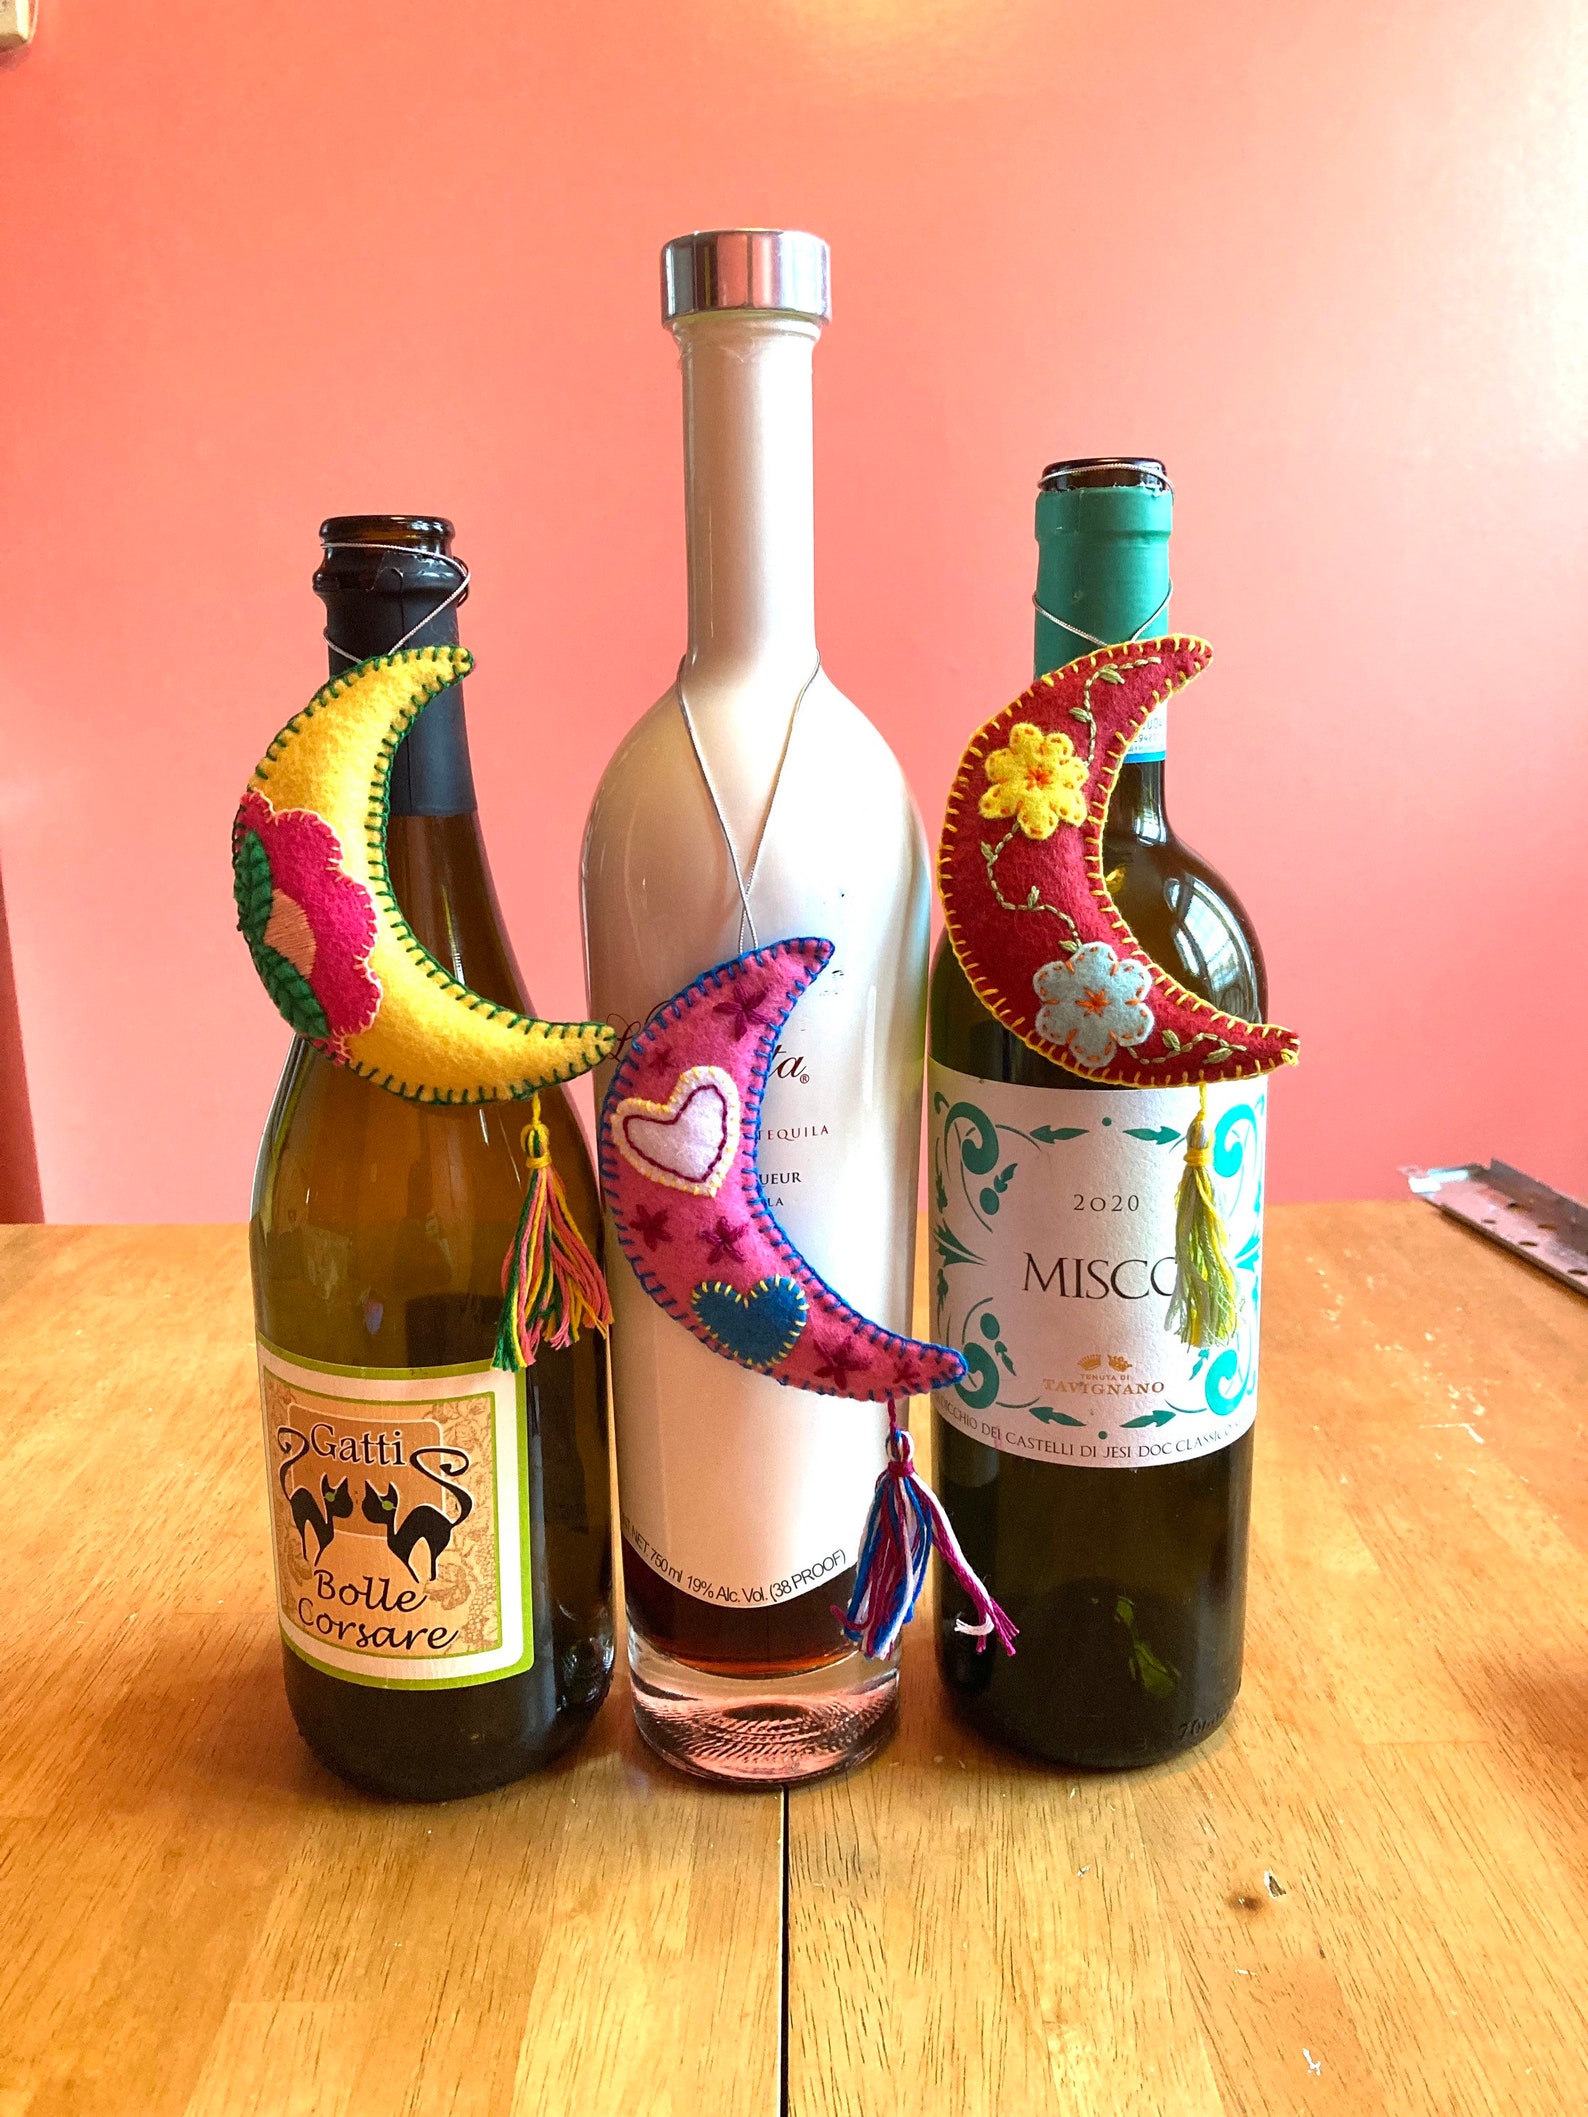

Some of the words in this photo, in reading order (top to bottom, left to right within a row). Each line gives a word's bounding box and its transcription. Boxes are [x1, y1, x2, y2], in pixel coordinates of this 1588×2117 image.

[1074, 1194, 1139, 1212] 2020
[1043, 1378, 1165, 1395] TAVIGNANO
[1080, 1373, 1117, 1381] TENUTA
[309, 1423, 406, 1466] Gatti
[1005, 1431, 1074, 1457] CASTELLI
[1080, 1446, 1097, 1458] DI
[1103, 1446, 1132, 1458] JESI
[1138, 1442, 1172, 1458] DOC
[313, 1569, 428, 1613] Bolle
[650, 1547, 669, 1573] 750
[668, 1566, 684, 1583] ml
[687, 1575, 714, 1599] 19%
[716, 1585, 741, 1603] Alc.
[742, 1586, 768, 1603] Vol.
[769, 1579, 792, 1603] (38
[791, 1549, 846, 1590] PROOF)
[298, 1597, 459, 1650] Corsare
